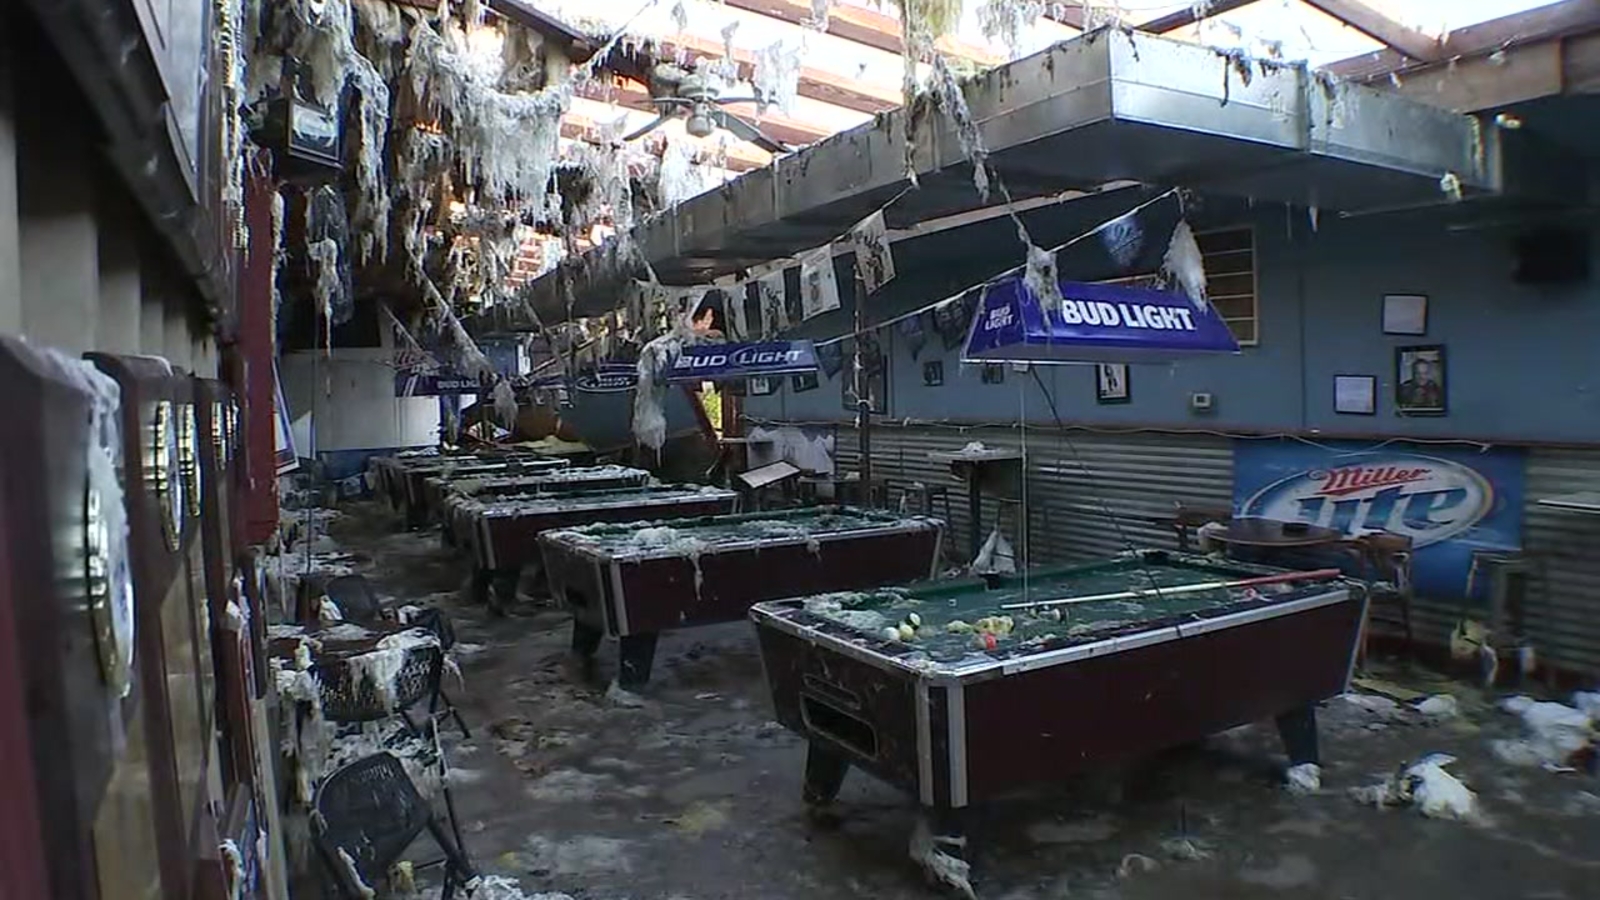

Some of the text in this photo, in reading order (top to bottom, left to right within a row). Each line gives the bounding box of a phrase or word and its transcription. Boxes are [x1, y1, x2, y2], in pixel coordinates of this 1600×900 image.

[990, 304, 1011, 320] BUD
[1062, 299, 1196, 330] BUD LIGHT
[985, 314, 1014, 330] LIGHT
[674, 350, 804, 368] BUD LIGHT
[1311, 467, 1433, 495] Miller
